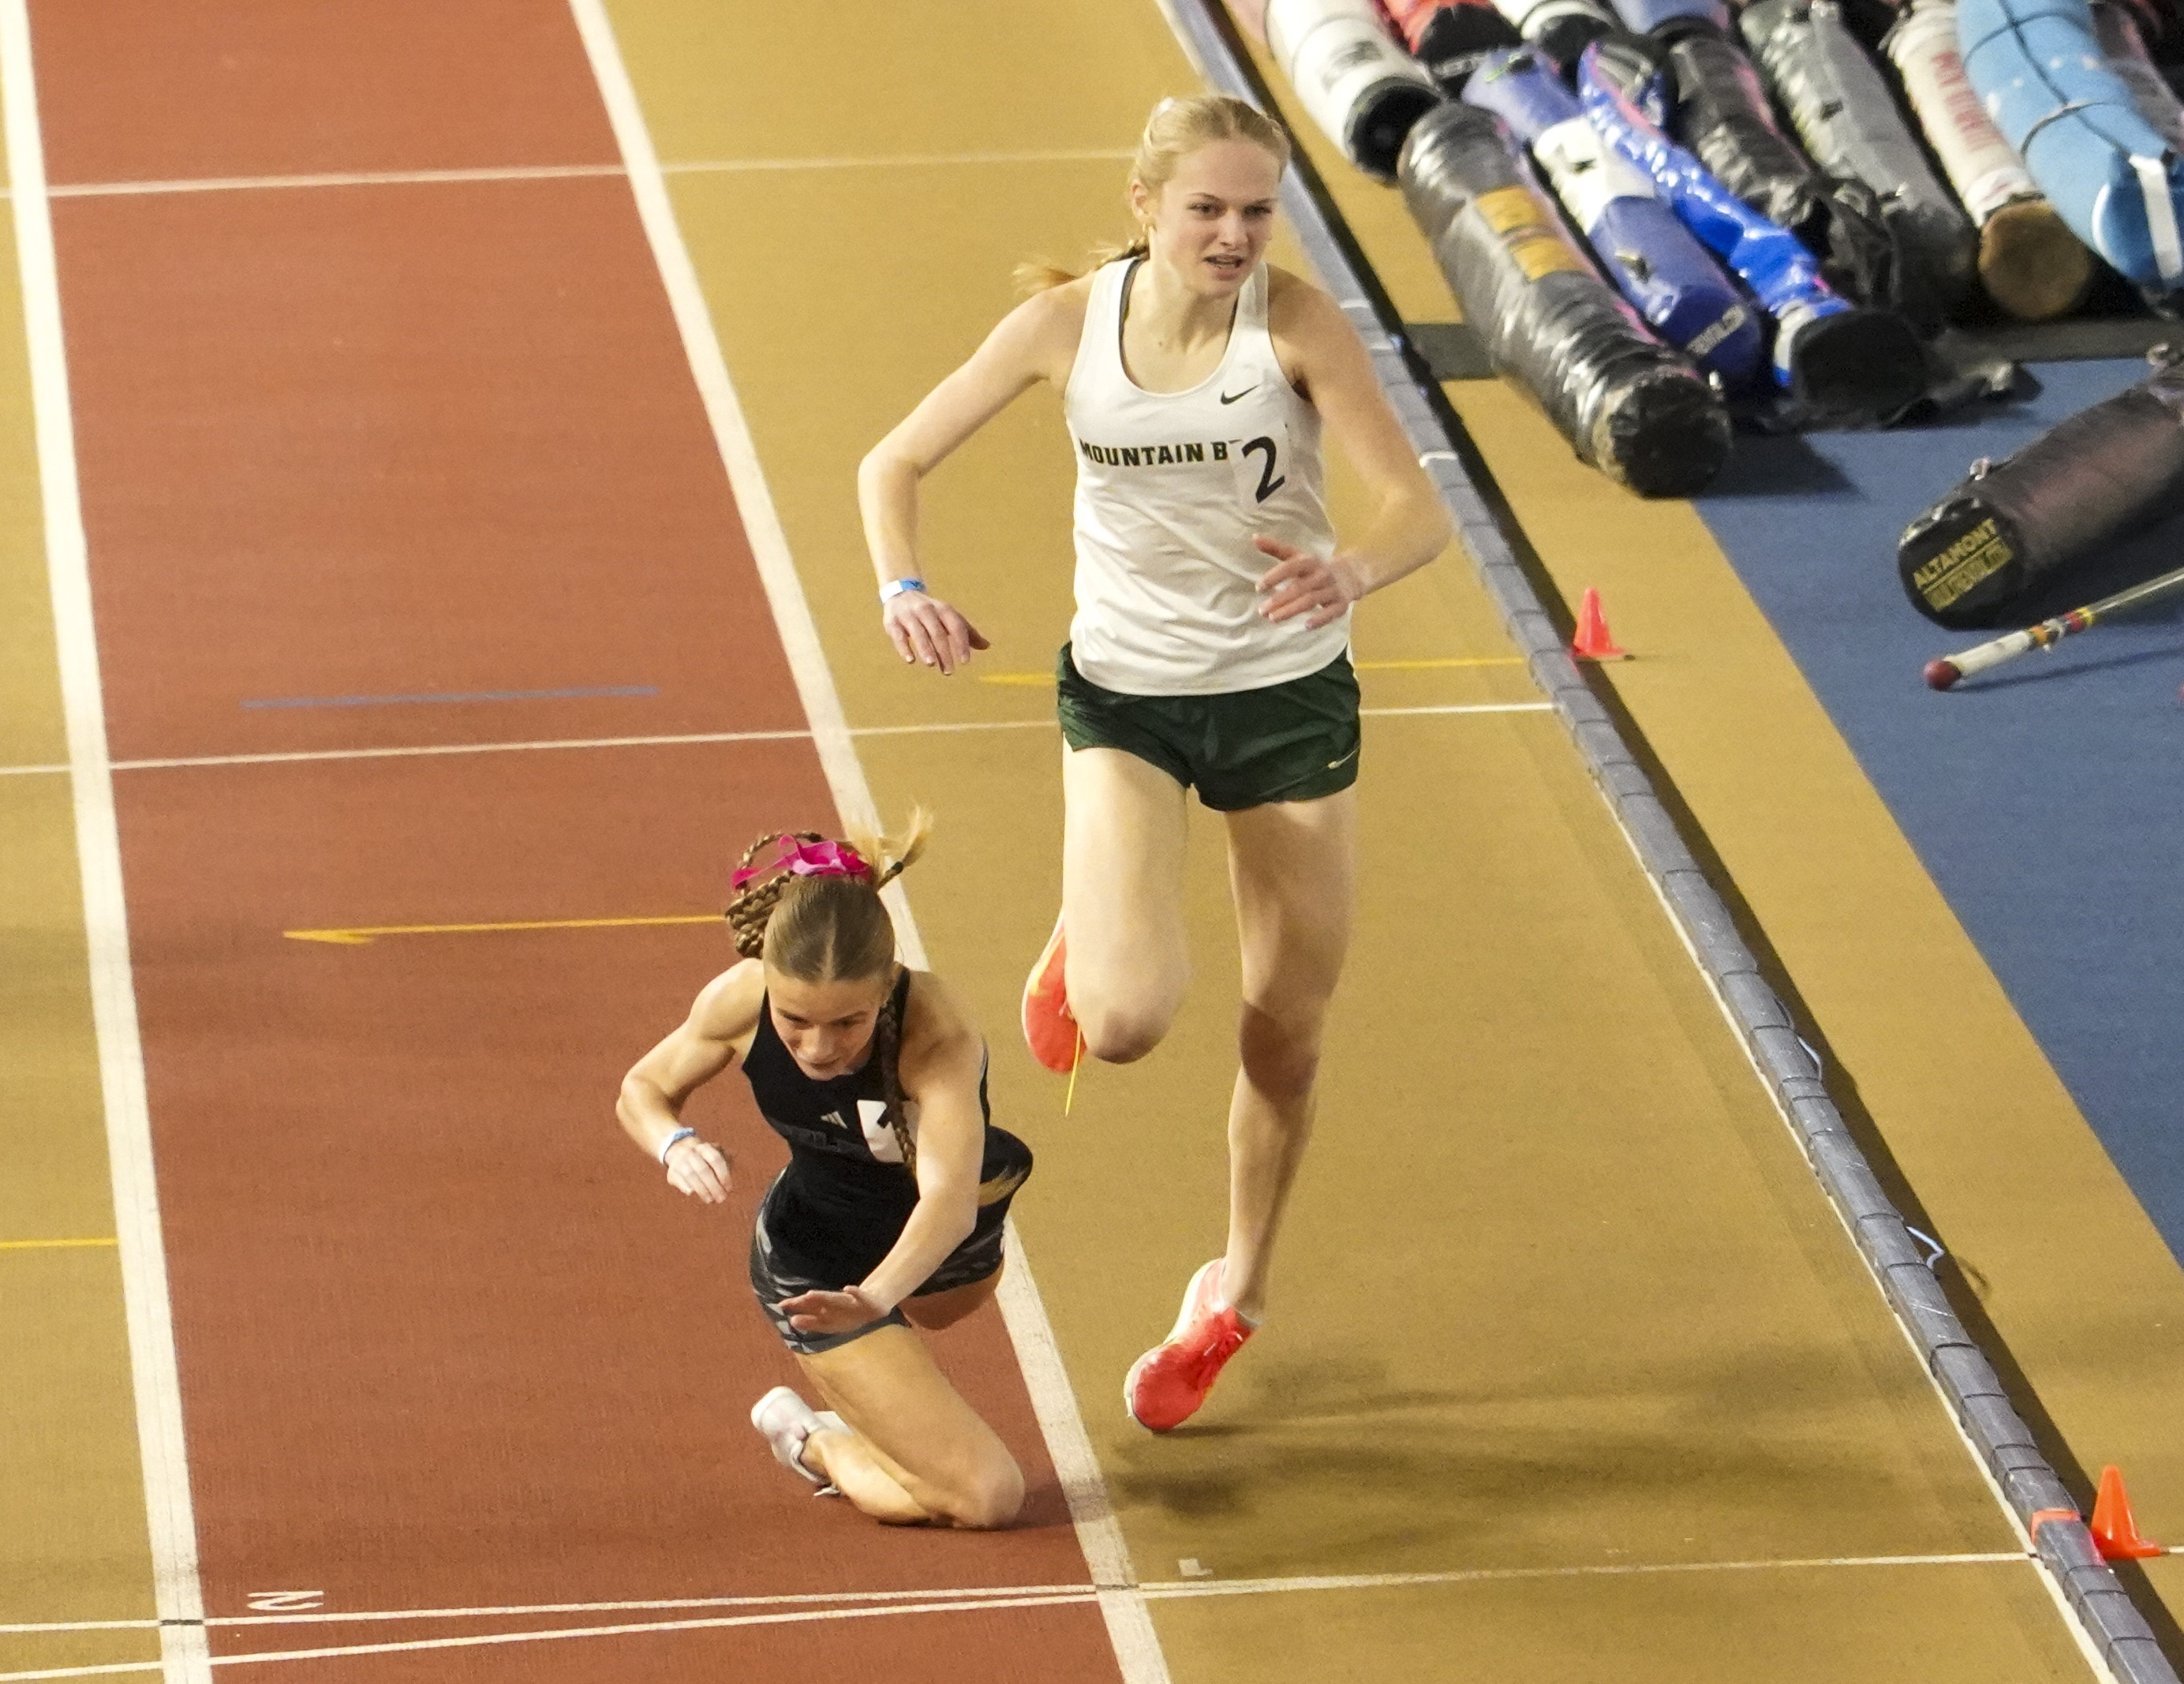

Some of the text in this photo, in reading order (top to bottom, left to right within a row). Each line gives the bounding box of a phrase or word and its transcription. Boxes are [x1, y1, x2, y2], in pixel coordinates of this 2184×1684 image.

[1079, 437, 1241, 466] MOUNTAIN B
[1242, 436, 1285, 503] 2
[1913, 518, 1997, 589] ALTAMONT
